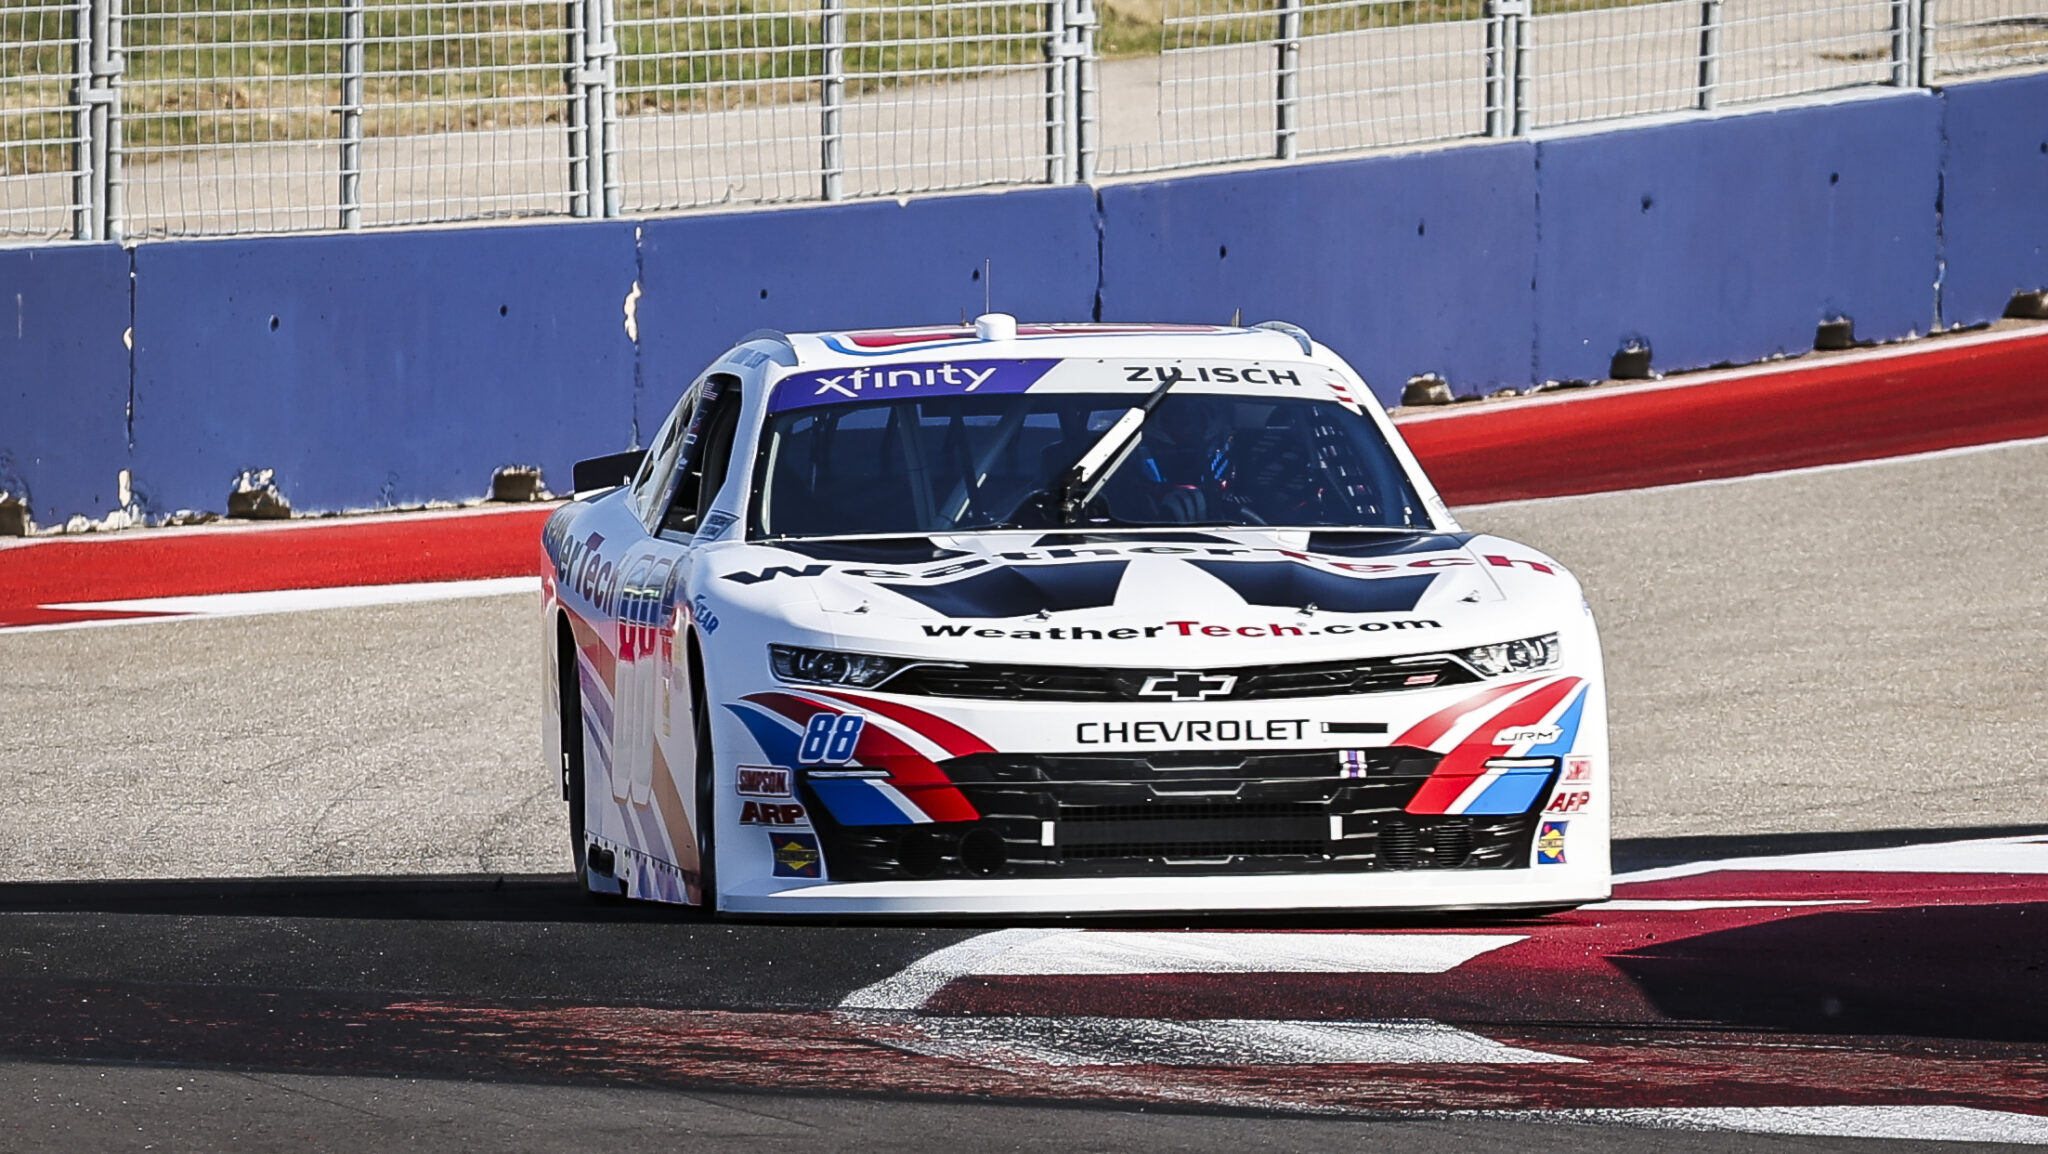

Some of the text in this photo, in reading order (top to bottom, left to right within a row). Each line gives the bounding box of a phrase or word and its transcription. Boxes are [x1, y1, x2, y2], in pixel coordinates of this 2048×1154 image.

[814, 363, 997, 398] xfinity
[1123, 366, 1302, 387] ZILISCH
[720, 548, 1556, 585] WeatherTech
[920, 616, 1443, 641] WeatherTech.com
[799, 712, 867, 762] 88
[1076, 718, 1311, 745] CHEVROLET
[1500, 730, 1554, 742] JRM
[739, 800, 805, 825] ARP
